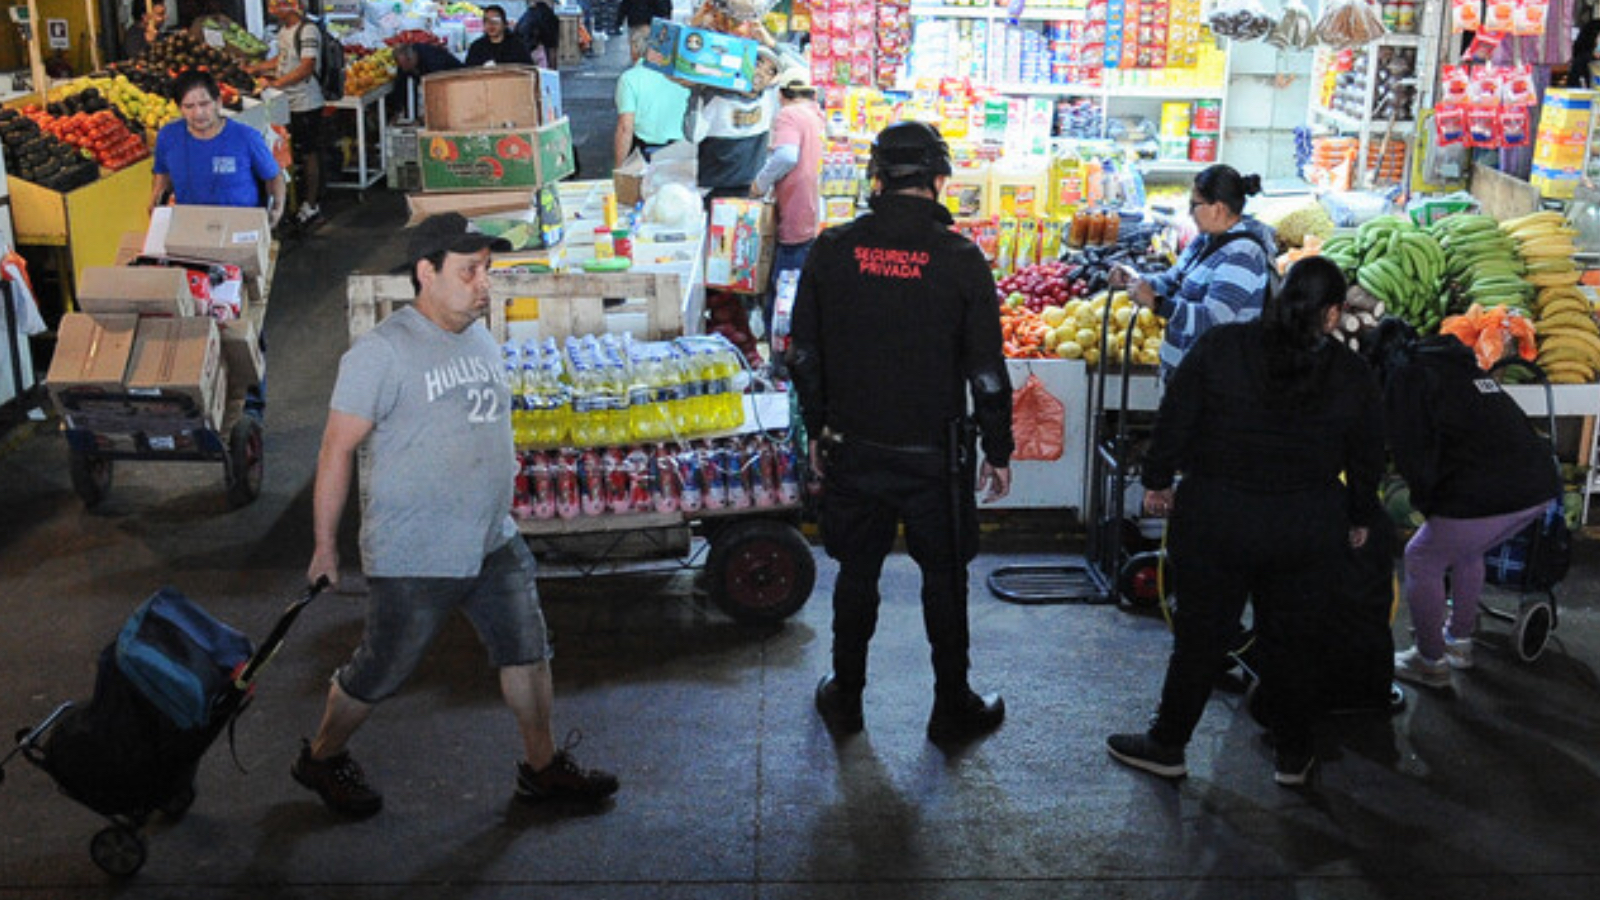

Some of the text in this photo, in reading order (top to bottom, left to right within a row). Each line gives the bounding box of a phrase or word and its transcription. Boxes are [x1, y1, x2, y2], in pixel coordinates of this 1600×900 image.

[854, 246, 929, 265] SEGURIDAD
[859, 260, 922, 279] PRIVADA
[467, 388, 499, 422] 22
